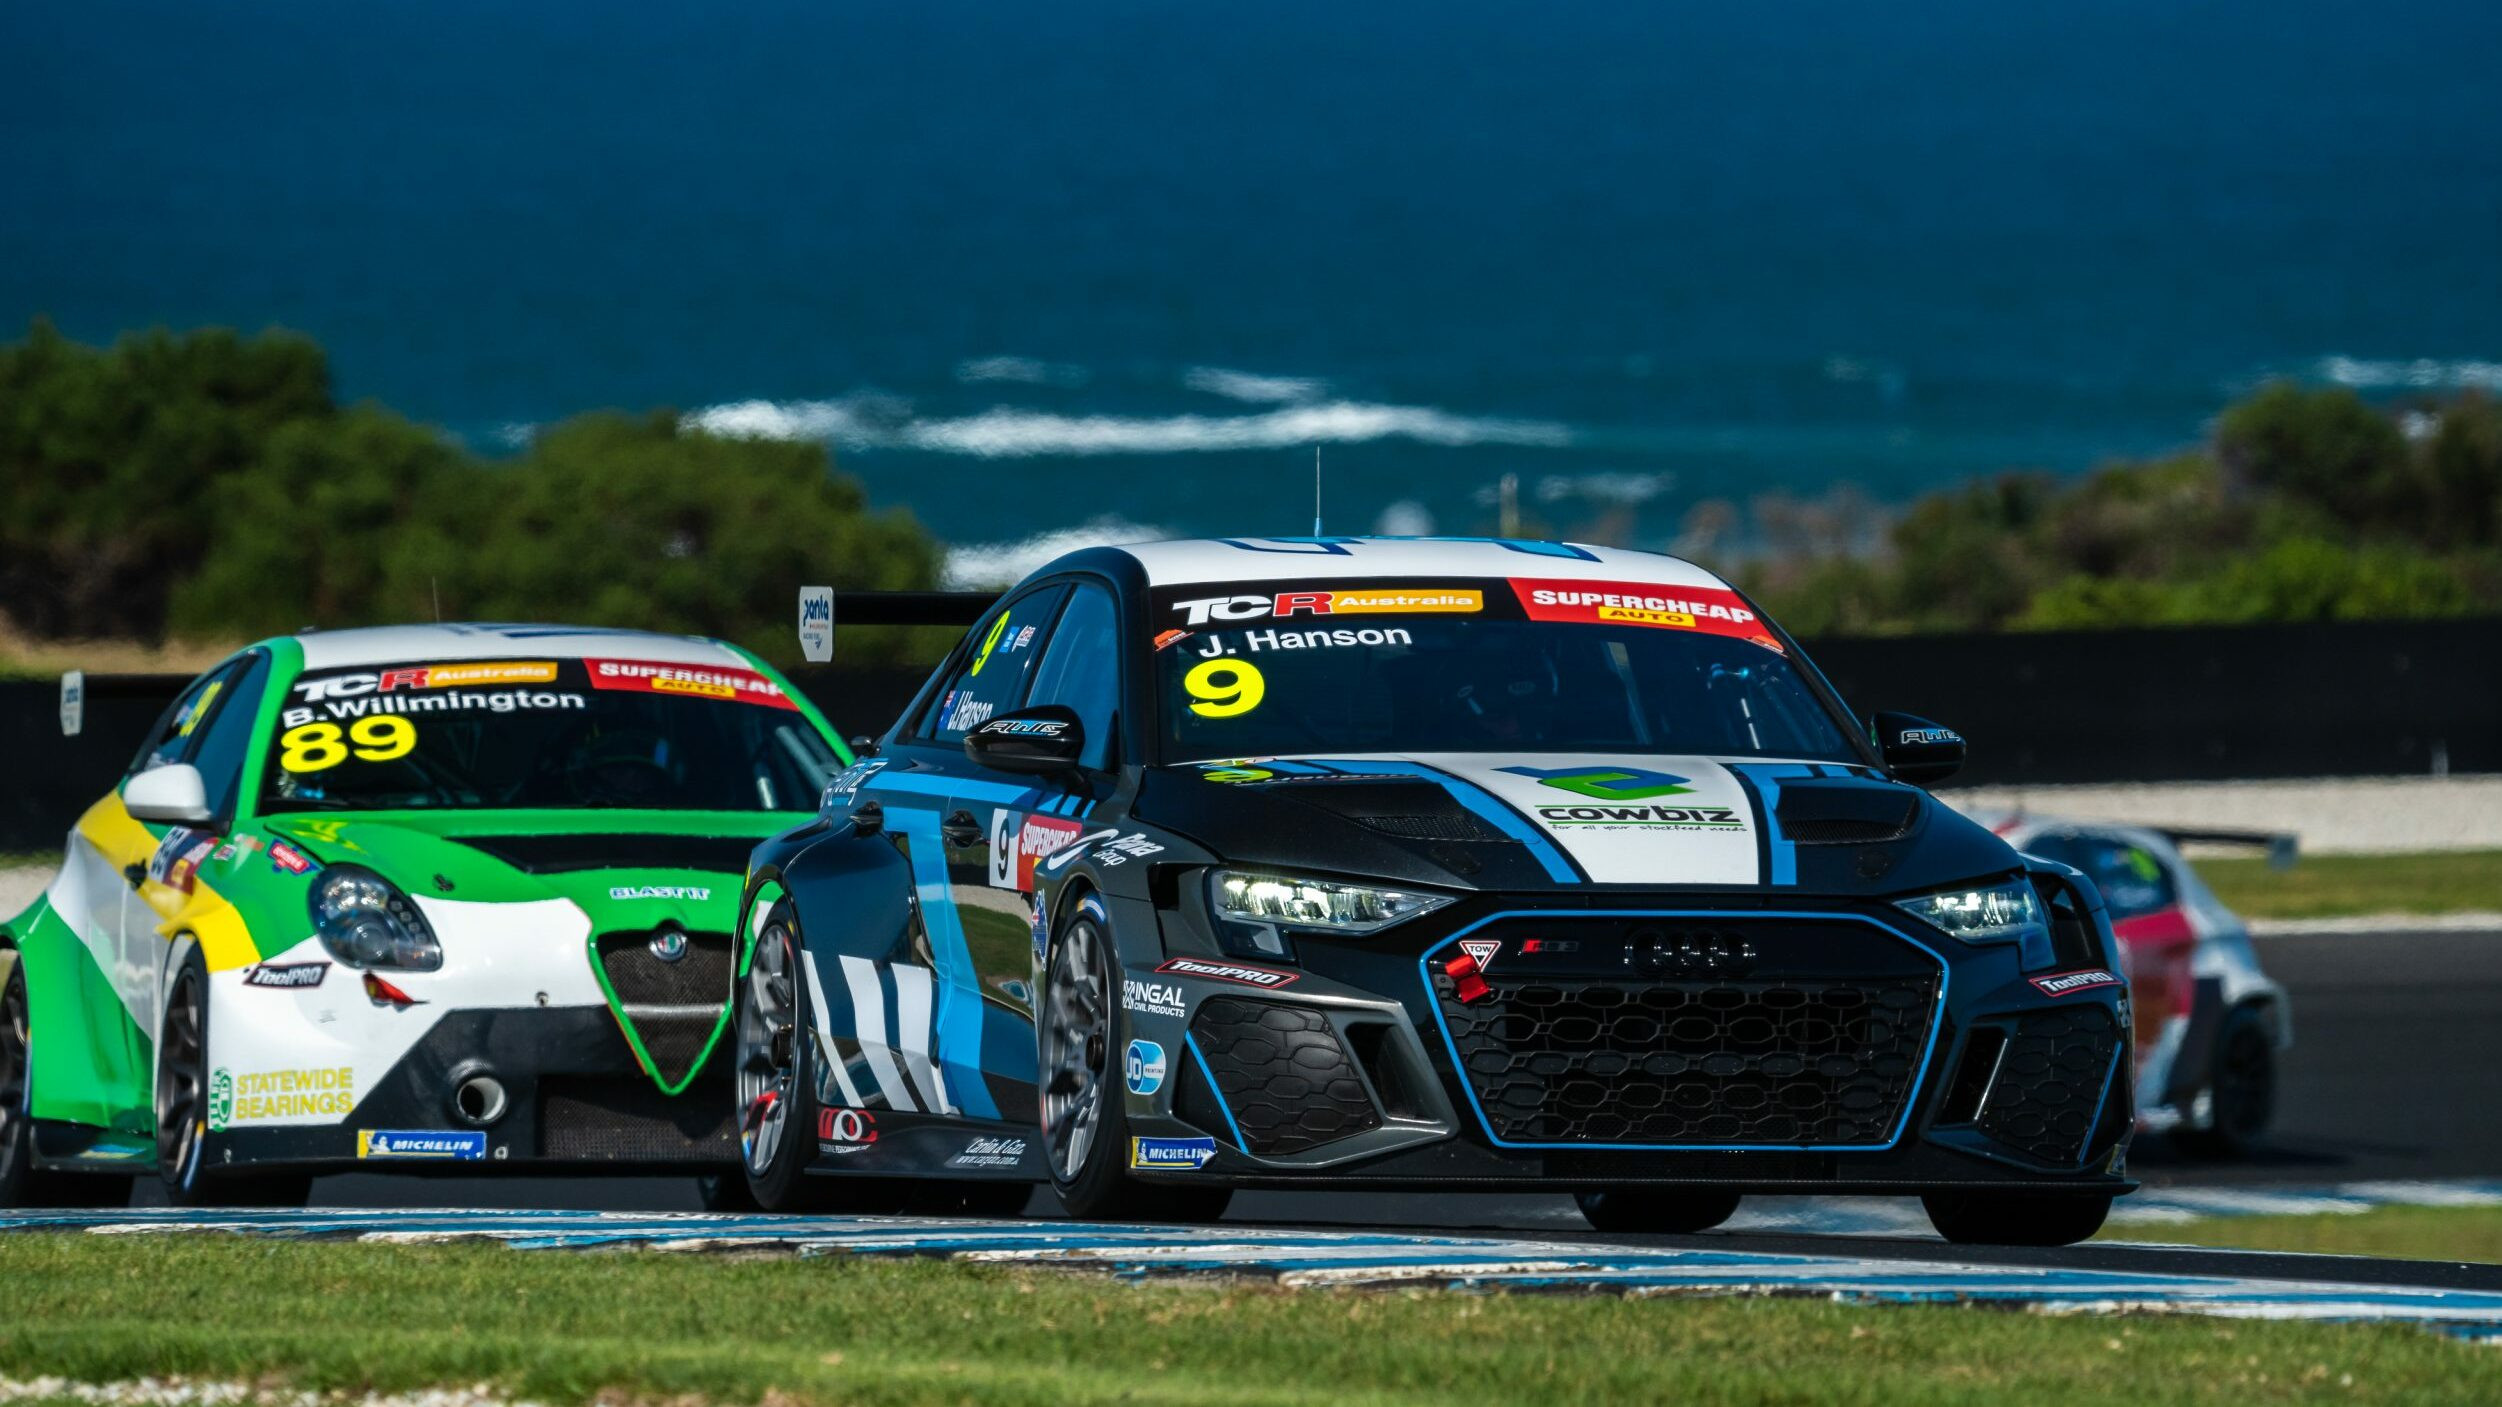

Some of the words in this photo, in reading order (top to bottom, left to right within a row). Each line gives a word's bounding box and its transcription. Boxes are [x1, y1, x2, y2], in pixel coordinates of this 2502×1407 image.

[1173, 592, 1335, 626] TCR
[1339, 595, 1473, 607] Australia
[1532, 590, 1754, 623] SUPERCHEAP
[1609, 609, 1685, 623] AUTO
[971, 610, 1011, 677] 9
[1199, 634, 1236, 658] J.
[1245, 628, 1412, 651] Hanson
[294, 669, 432, 702] TCR
[434, 667, 549, 681] Australia
[661, 681, 727, 694] AUTO
[1184, 658, 1265, 719] 9
[281, 715, 417, 773] 89
[998, 817, 1010, 881] 9
[1469, 945, 1492, 953] TOW
[252, 966, 322, 985] ToolPRO
[1169, 961, 1281, 984] ToolPRO
[2040, 972, 2114, 992] ToolPRO
[1148, 1004, 1185, 1017] PRODUCTS
[237, 1067, 353, 1095] STATEWIDE
[236, 1091, 353, 1119] BEARINGS
[392, 1140, 473, 1151] MICHELIN
[1148, 1148, 1209, 1160] MICHELIN
